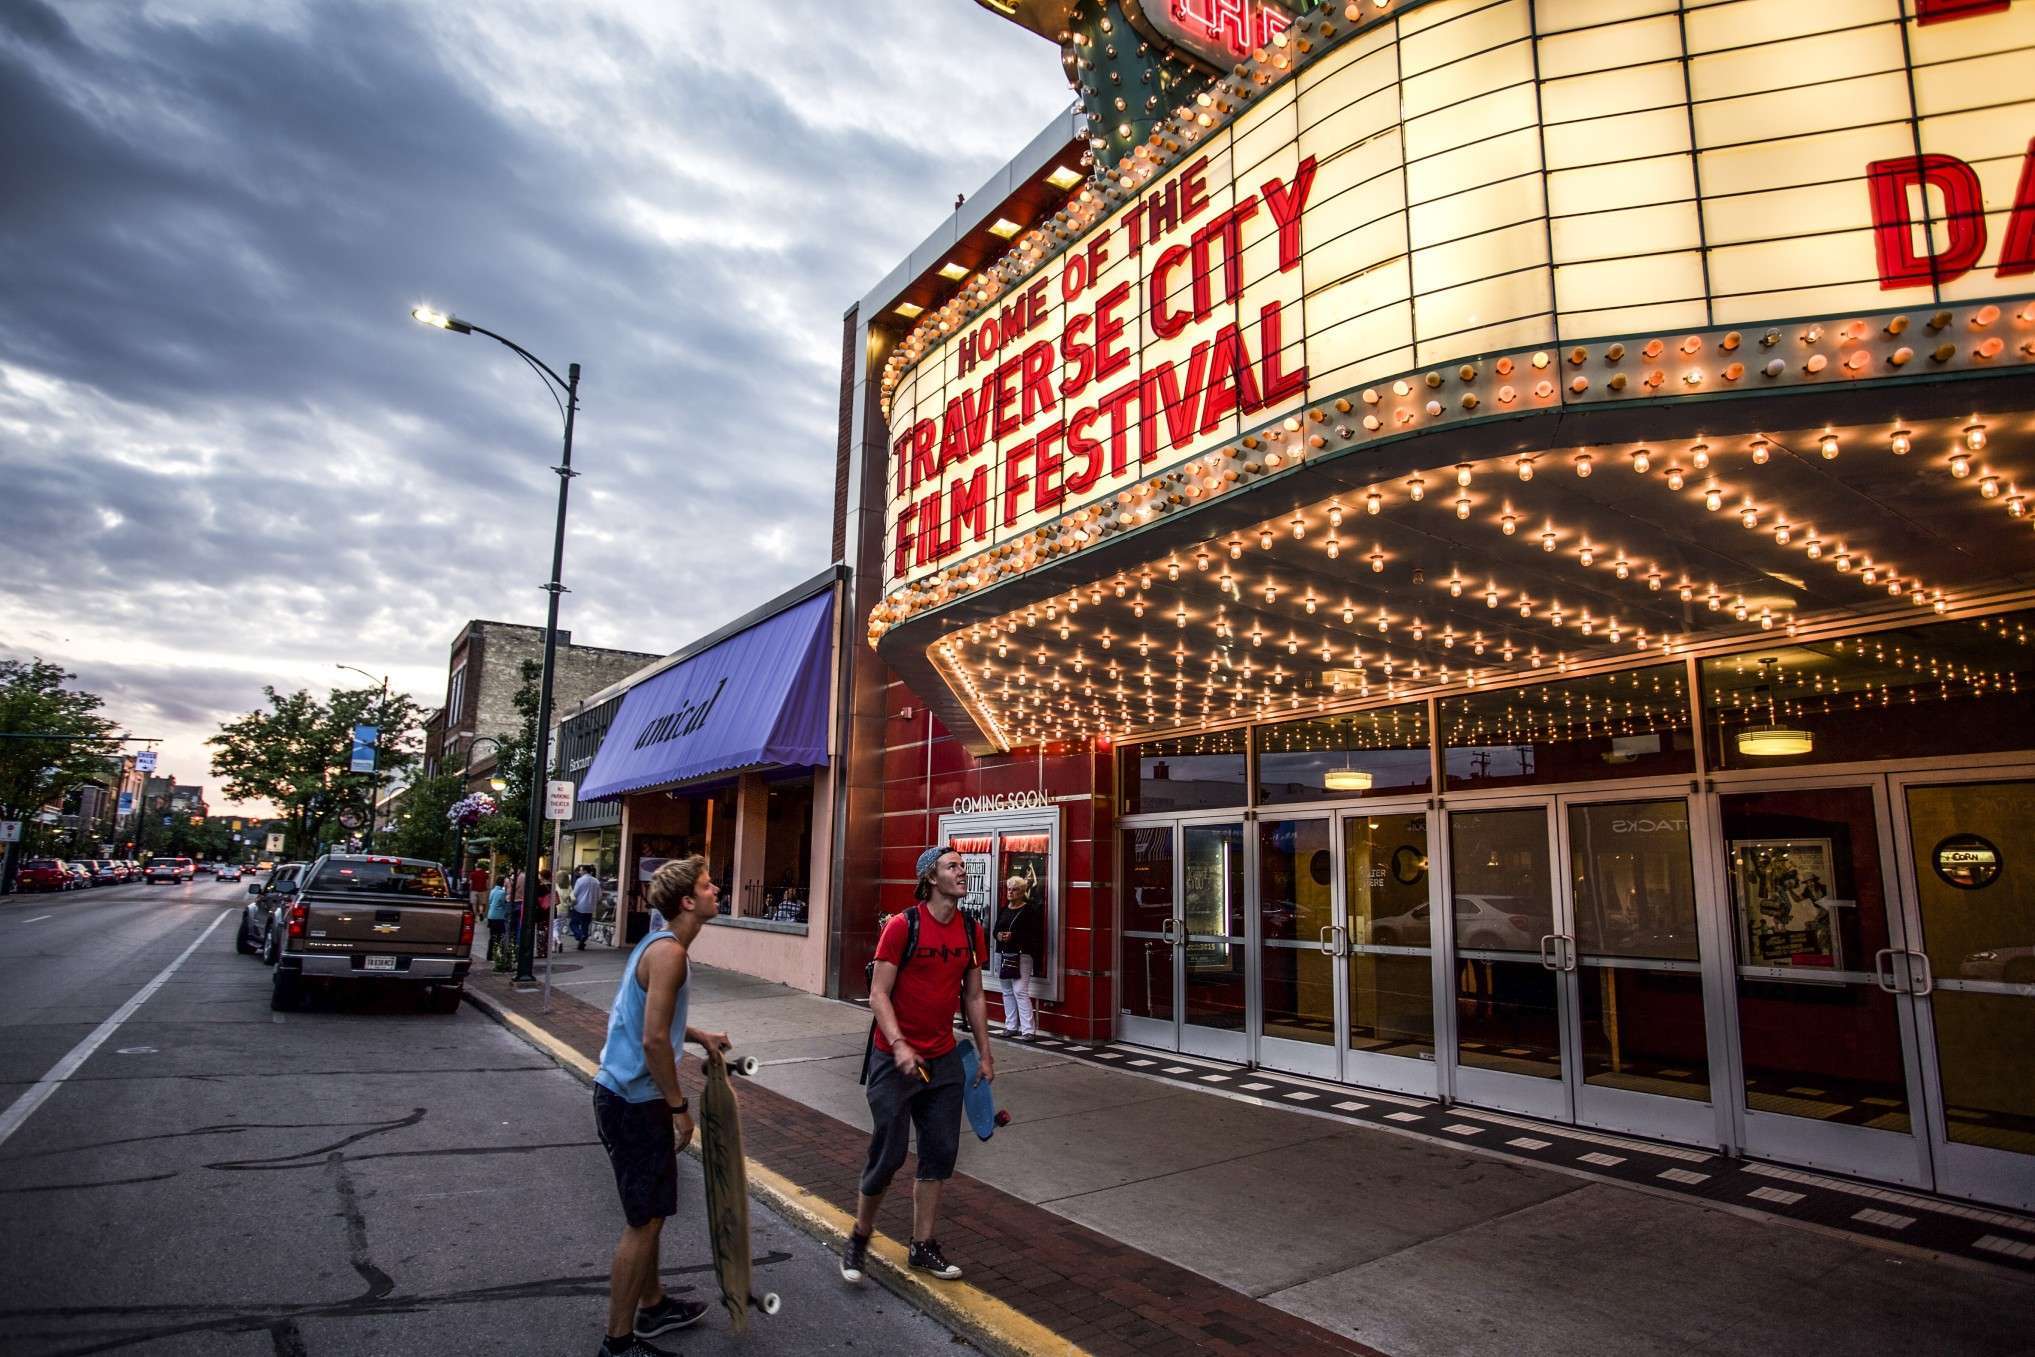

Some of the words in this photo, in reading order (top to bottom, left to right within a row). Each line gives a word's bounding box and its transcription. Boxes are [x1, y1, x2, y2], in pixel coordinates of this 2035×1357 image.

[893, 281, 1131, 499] TRAVERSE
[1150, 154, 1317, 340] CITY
[957, 277, 1049, 379] HOME
[1061, 231, 1111, 302] OF
[1121, 155, 1210, 259] THE
[894, 463, 988, 579] FILM
[1003, 300, 1310, 528] FESTIVAL
[634, 677, 728, 750] amical
[953, 793, 1004, 814] COMING
[1007, 789, 1048, 809] SOON
